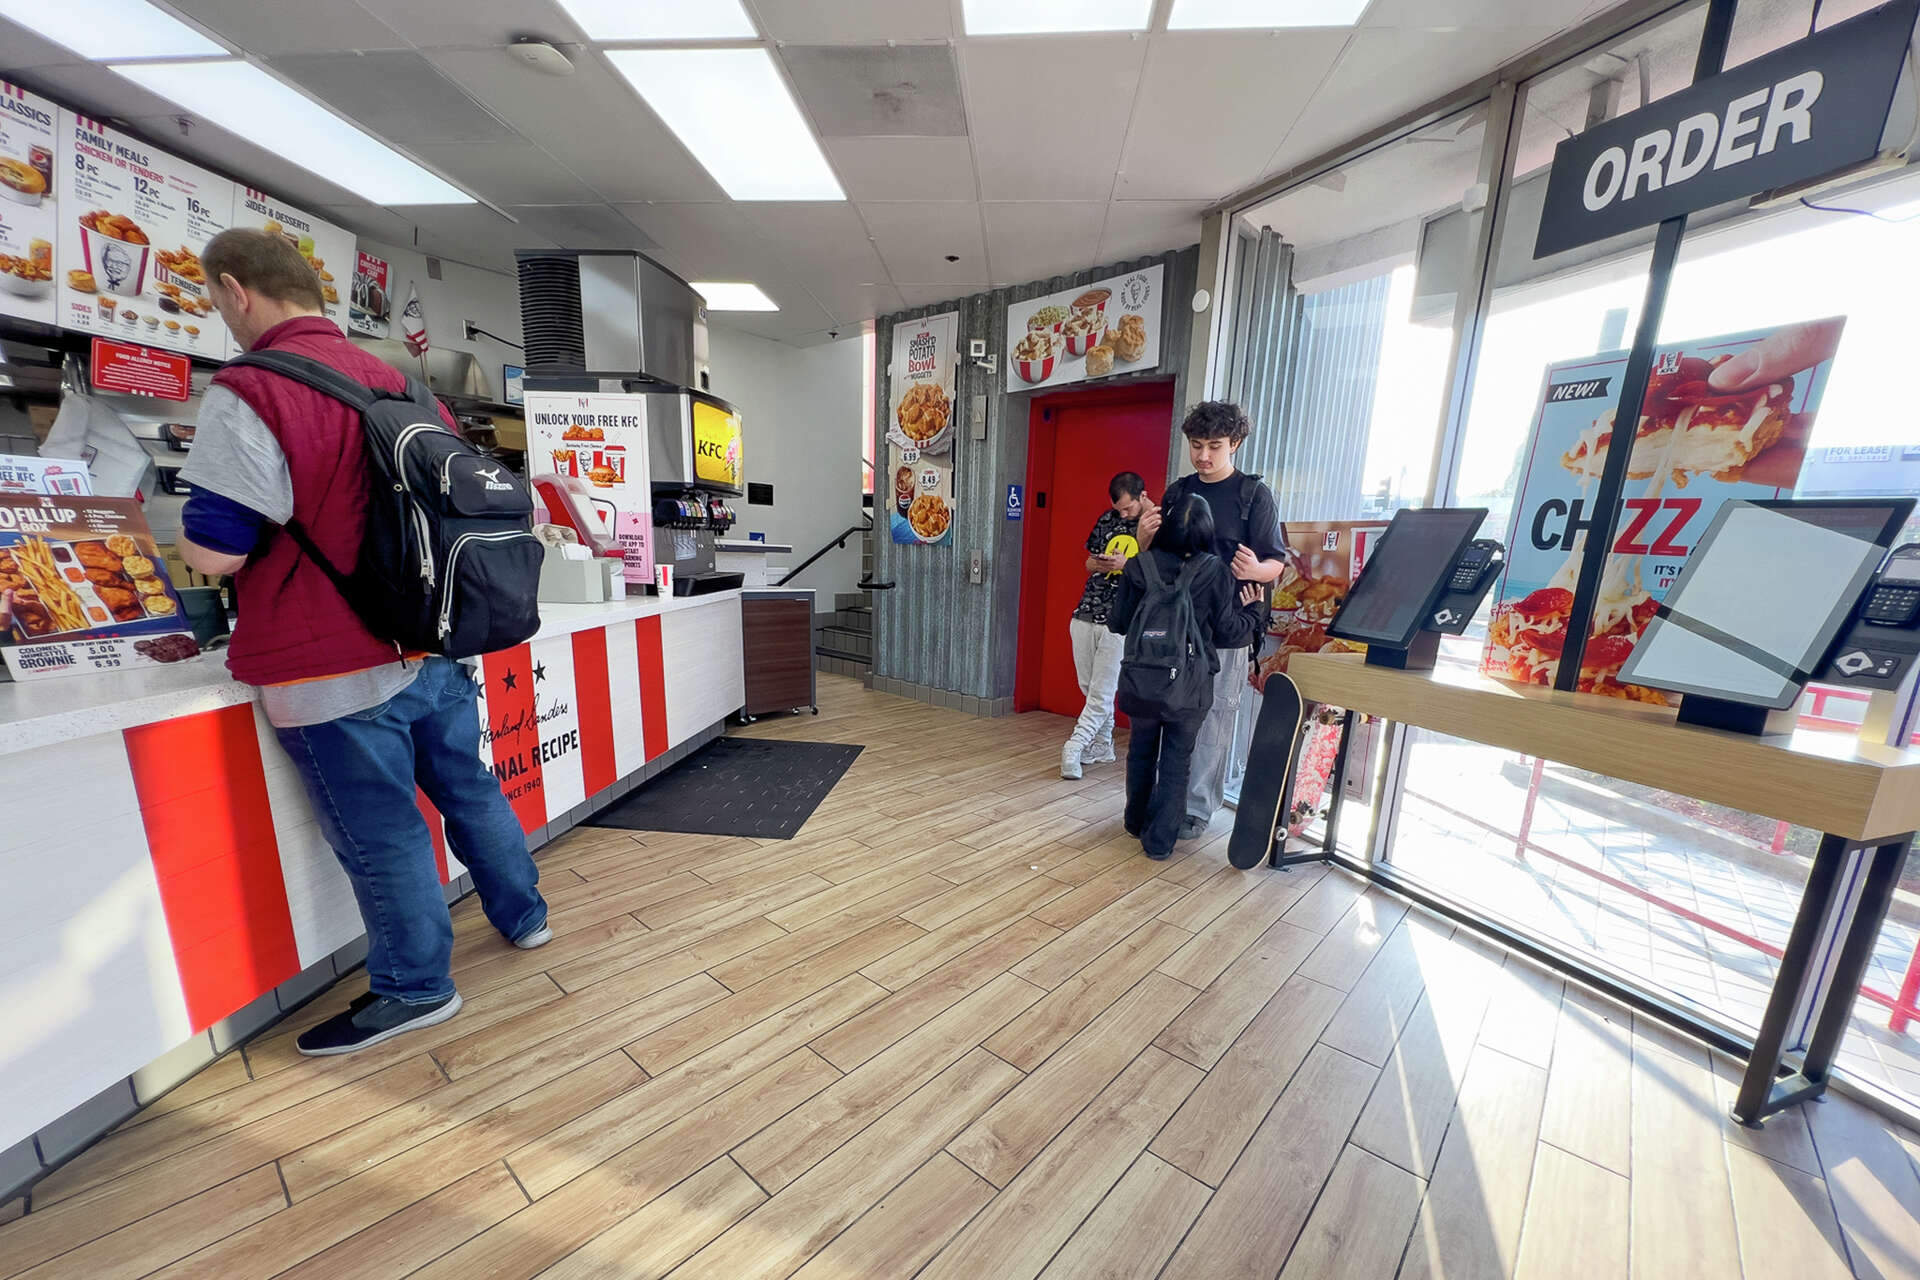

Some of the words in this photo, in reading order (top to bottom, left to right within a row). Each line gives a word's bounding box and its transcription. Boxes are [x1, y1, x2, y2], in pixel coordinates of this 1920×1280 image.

[0, 95, 51, 126] LASSICS
[75, 128, 113, 151] FAMILY
[116, 145, 149, 166] MEALS
[1583, 70, 1824, 212] ORDER
[74, 141, 113, 163] CHICKEN
[115, 157, 127, 168] OR
[129, 163, 164, 184] TENDERS
[75, 154, 85, 170] 8
[87, 164, 98, 176] PC
[133, 177, 148, 195] 12
[149, 188, 160, 199] PC
[186, 197, 200, 213] 16
[200, 208, 211, 218] PC
[245, 200, 267, 215] SIDES
[275, 211, 311, 232] DESSERTS
[170, 275, 202, 295] TENDERS
[909, 345, 935, 360] POTATO
[908, 355, 936, 373] BOWL
[1552, 381, 1600, 401] NEW!
[535, 413, 569, 425] UNLOCK
[571, 414, 595, 426] YOUR
[597, 415, 619, 427] FREE
[621, 415, 639, 428] KFC
[697, 439, 722, 460] KFC
[1830, 447, 1850, 455] FOR
[1854, 446, 1889, 455] LEASE
[16, 472, 35, 482] KFC
[13, 507, 54, 523] FILL
[50, 508, 77, 523] UP
[20, 522, 50, 533] BOX
[1531, 498, 1704, 557] CHZZ
[1654, 565, 1676, 576] IT'S
[88, 645, 115, 655] 5.00
[19, 655, 77, 669] BROWNIE
[94, 659, 121, 668] 6.99
[532, 729, 579, 768] RECIPE
[504, 786, 522, 803] INCE
[523, 777, 541, 794] 1940
